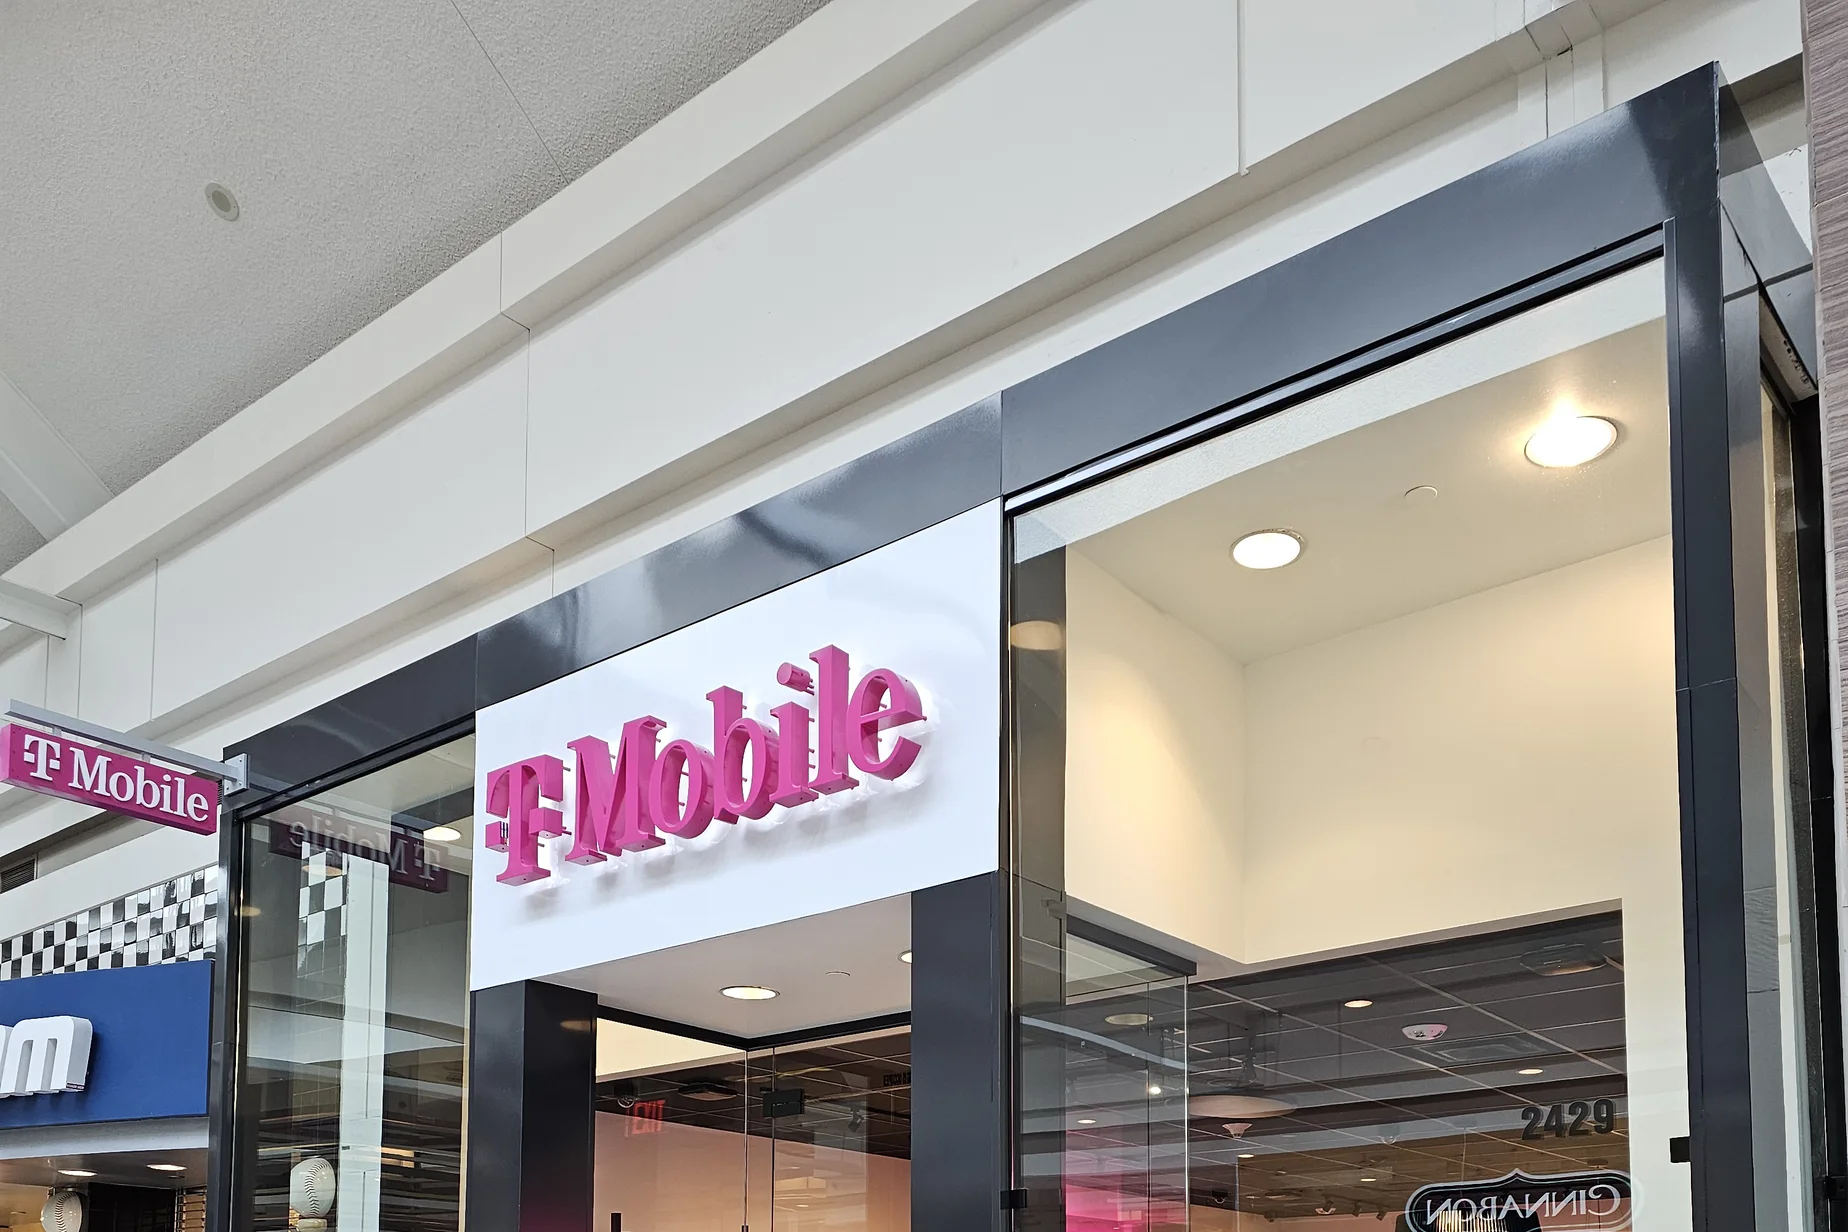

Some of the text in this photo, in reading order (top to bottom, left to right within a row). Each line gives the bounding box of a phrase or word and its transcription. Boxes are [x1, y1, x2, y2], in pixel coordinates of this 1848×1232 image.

[566, 644, 923, 865] Mobile
[68, 747, 209, 822] Mobile
[632, 1100, 665, 1134] EXIT
[1522, 1099, 1616, 1141] 2429
